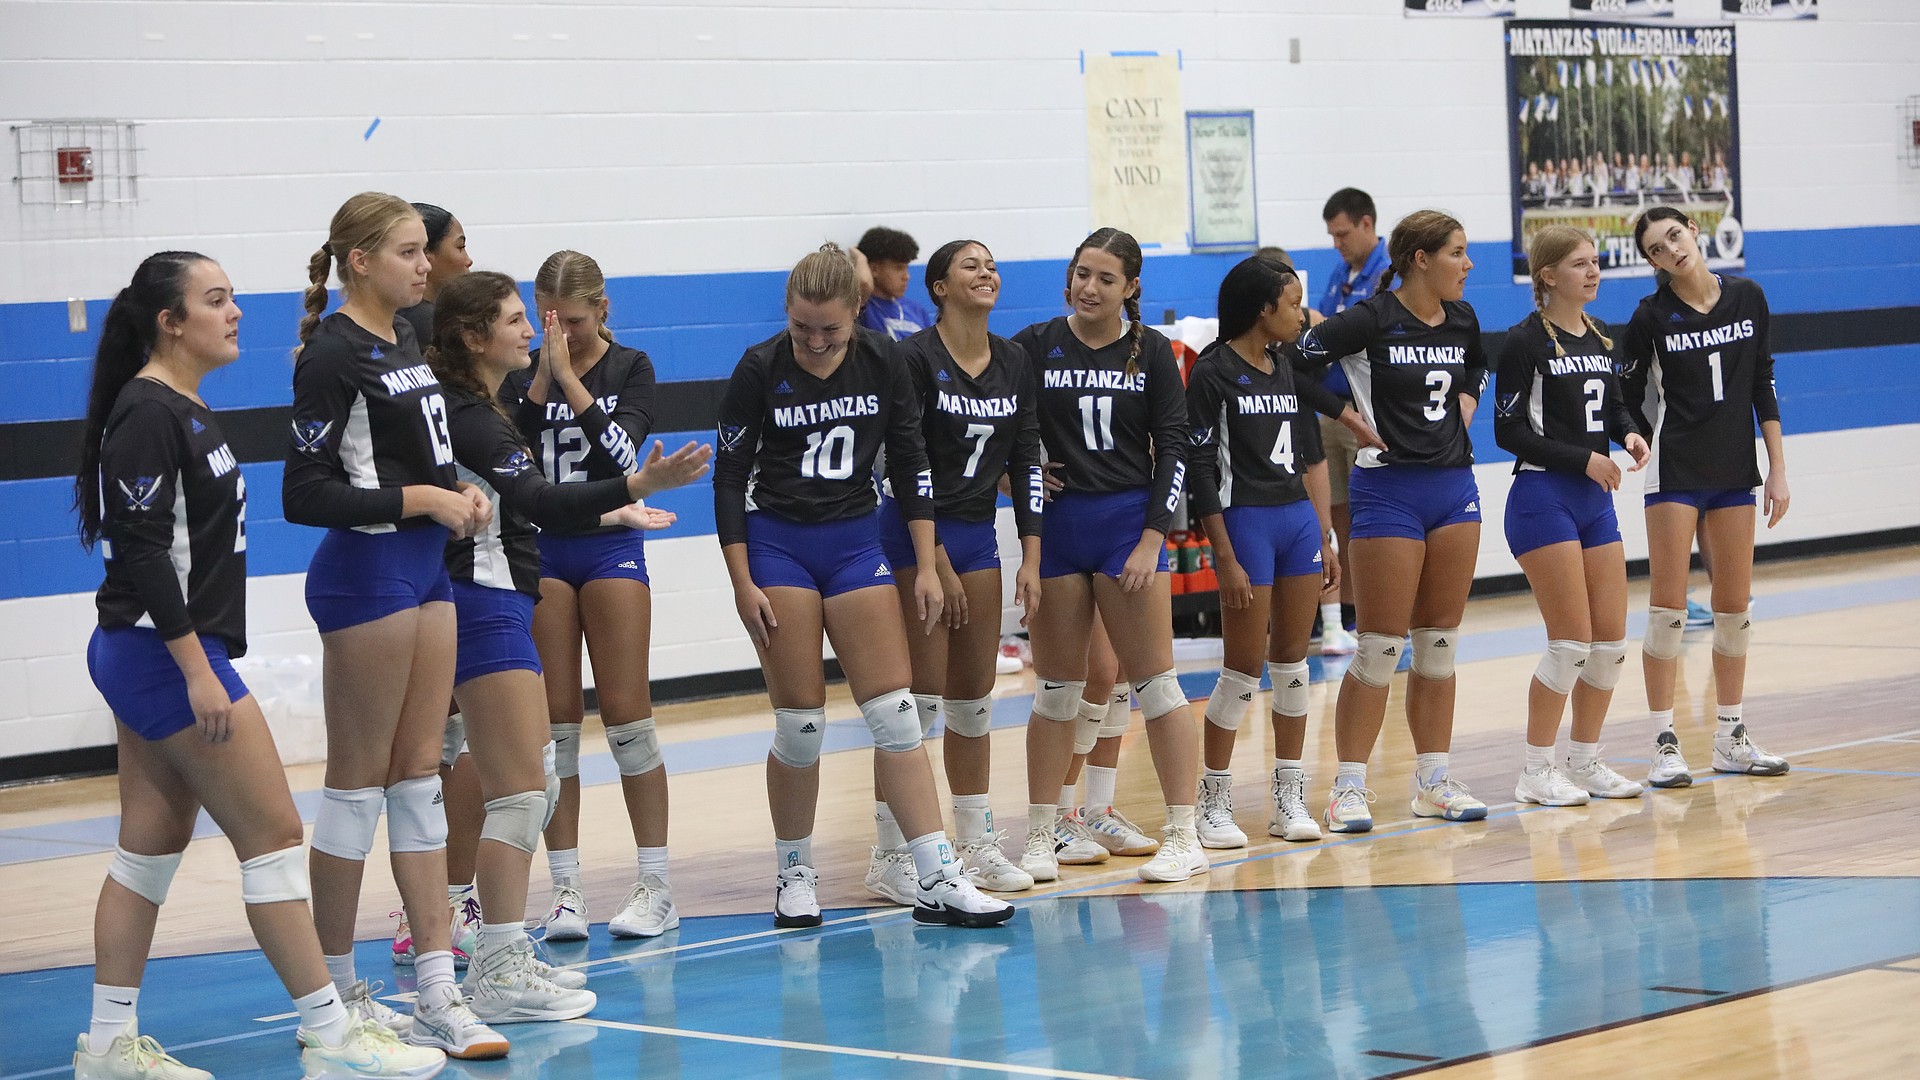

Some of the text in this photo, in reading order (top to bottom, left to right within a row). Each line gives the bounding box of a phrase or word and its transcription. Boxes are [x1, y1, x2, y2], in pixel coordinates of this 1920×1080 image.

[1509, 27, 1732, 56] MATANZAS VOLLEYBALL 2023
[1113, 165, 1161, 186] MIND
[1665, 319, 1753, 352] MATANZAS
[380, 363, 439, 396] MATANZ
[1044, 369, 1146, 391] MATANZAS
[1423, 370, 1452, 421] 3
[1708, 351, 1724, 402] 1
[420, 393, 454, 466] 13
[774, 394, 879, 427] MATANZAS
[1078, 395, 1114, 450] 11
[1237, 394, 1298, 414] MATANZ
[1583, 378, 1605, 432] 2
[541, 426, 592, 485] 12
[801, 425, 855, 480] 10
[962, 423, 995, 477] 7
[1269, 420, 1296, 474] 4
